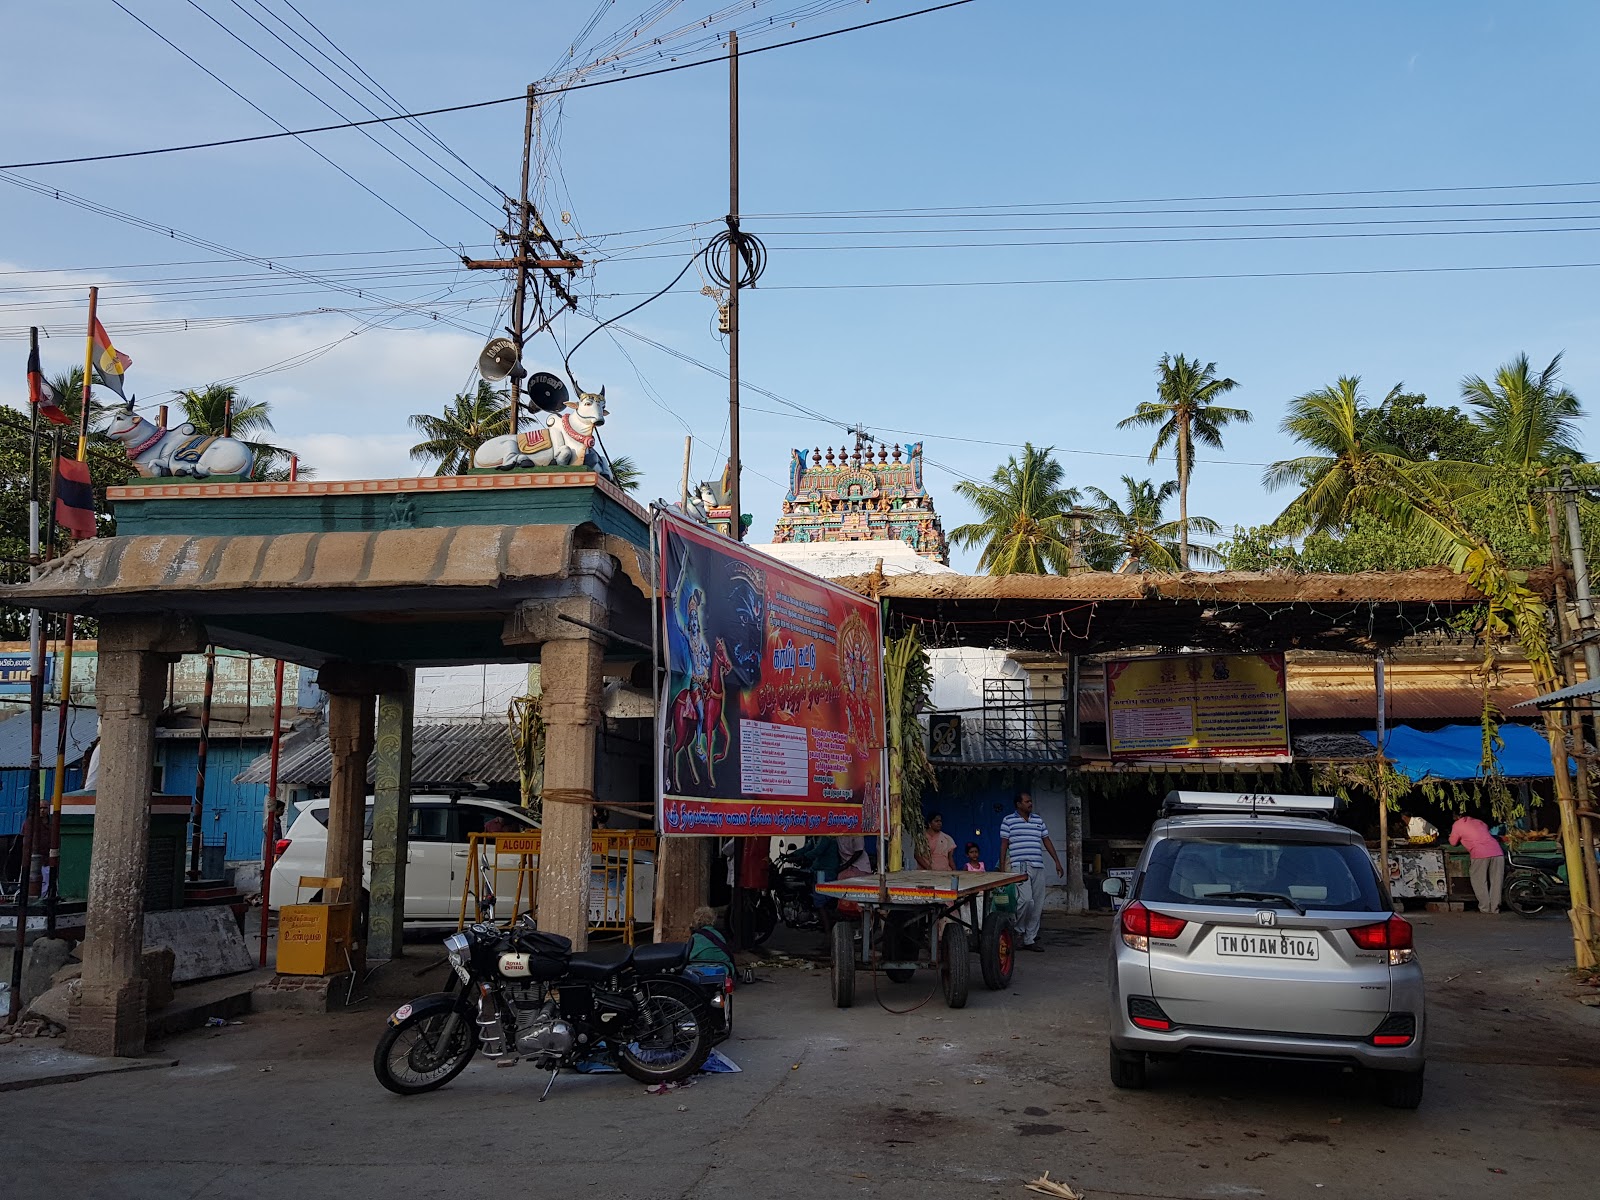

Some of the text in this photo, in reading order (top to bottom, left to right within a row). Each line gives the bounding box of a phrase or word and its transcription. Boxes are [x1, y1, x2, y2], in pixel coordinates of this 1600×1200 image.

[798, 643, 817, 671] கட்டு
[502, 840, 534, 850] ALGUDI
[1220, 936, 1314, 956] TN 01 AW 8104
